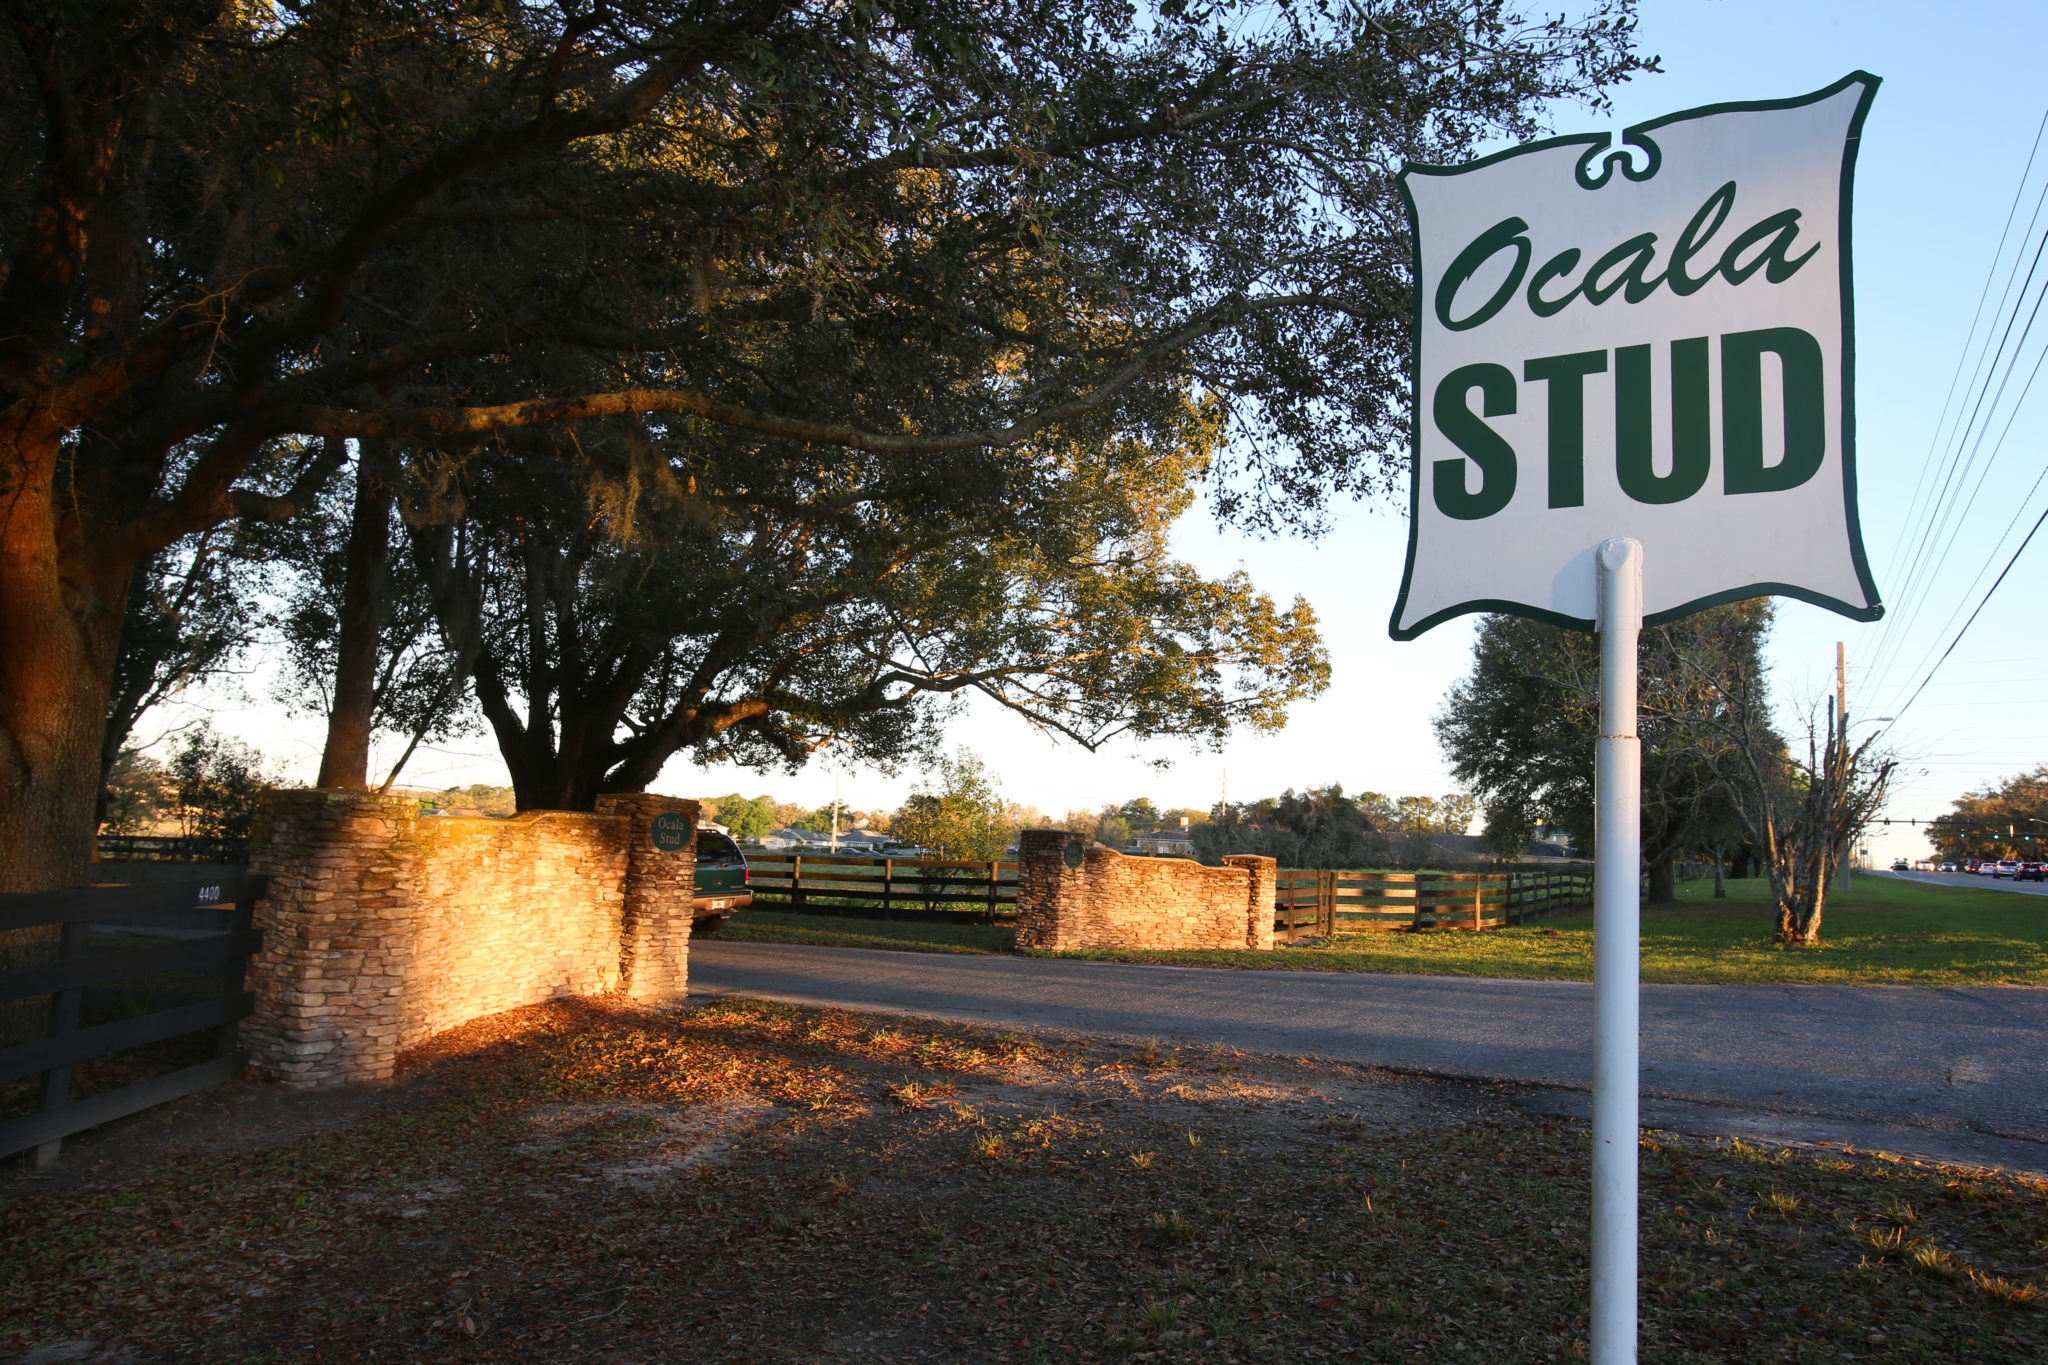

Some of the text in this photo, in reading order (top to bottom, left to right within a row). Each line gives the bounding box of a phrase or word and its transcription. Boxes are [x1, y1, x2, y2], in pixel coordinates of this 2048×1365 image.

[1435, 180, 1821, 332] Ocala
[1433, 327, 1826, 521] STUD
[658, 817, 684, 831] Ocala
[660, 832, 681, 845] Stud
[198, 886, 220, 901] 4400
